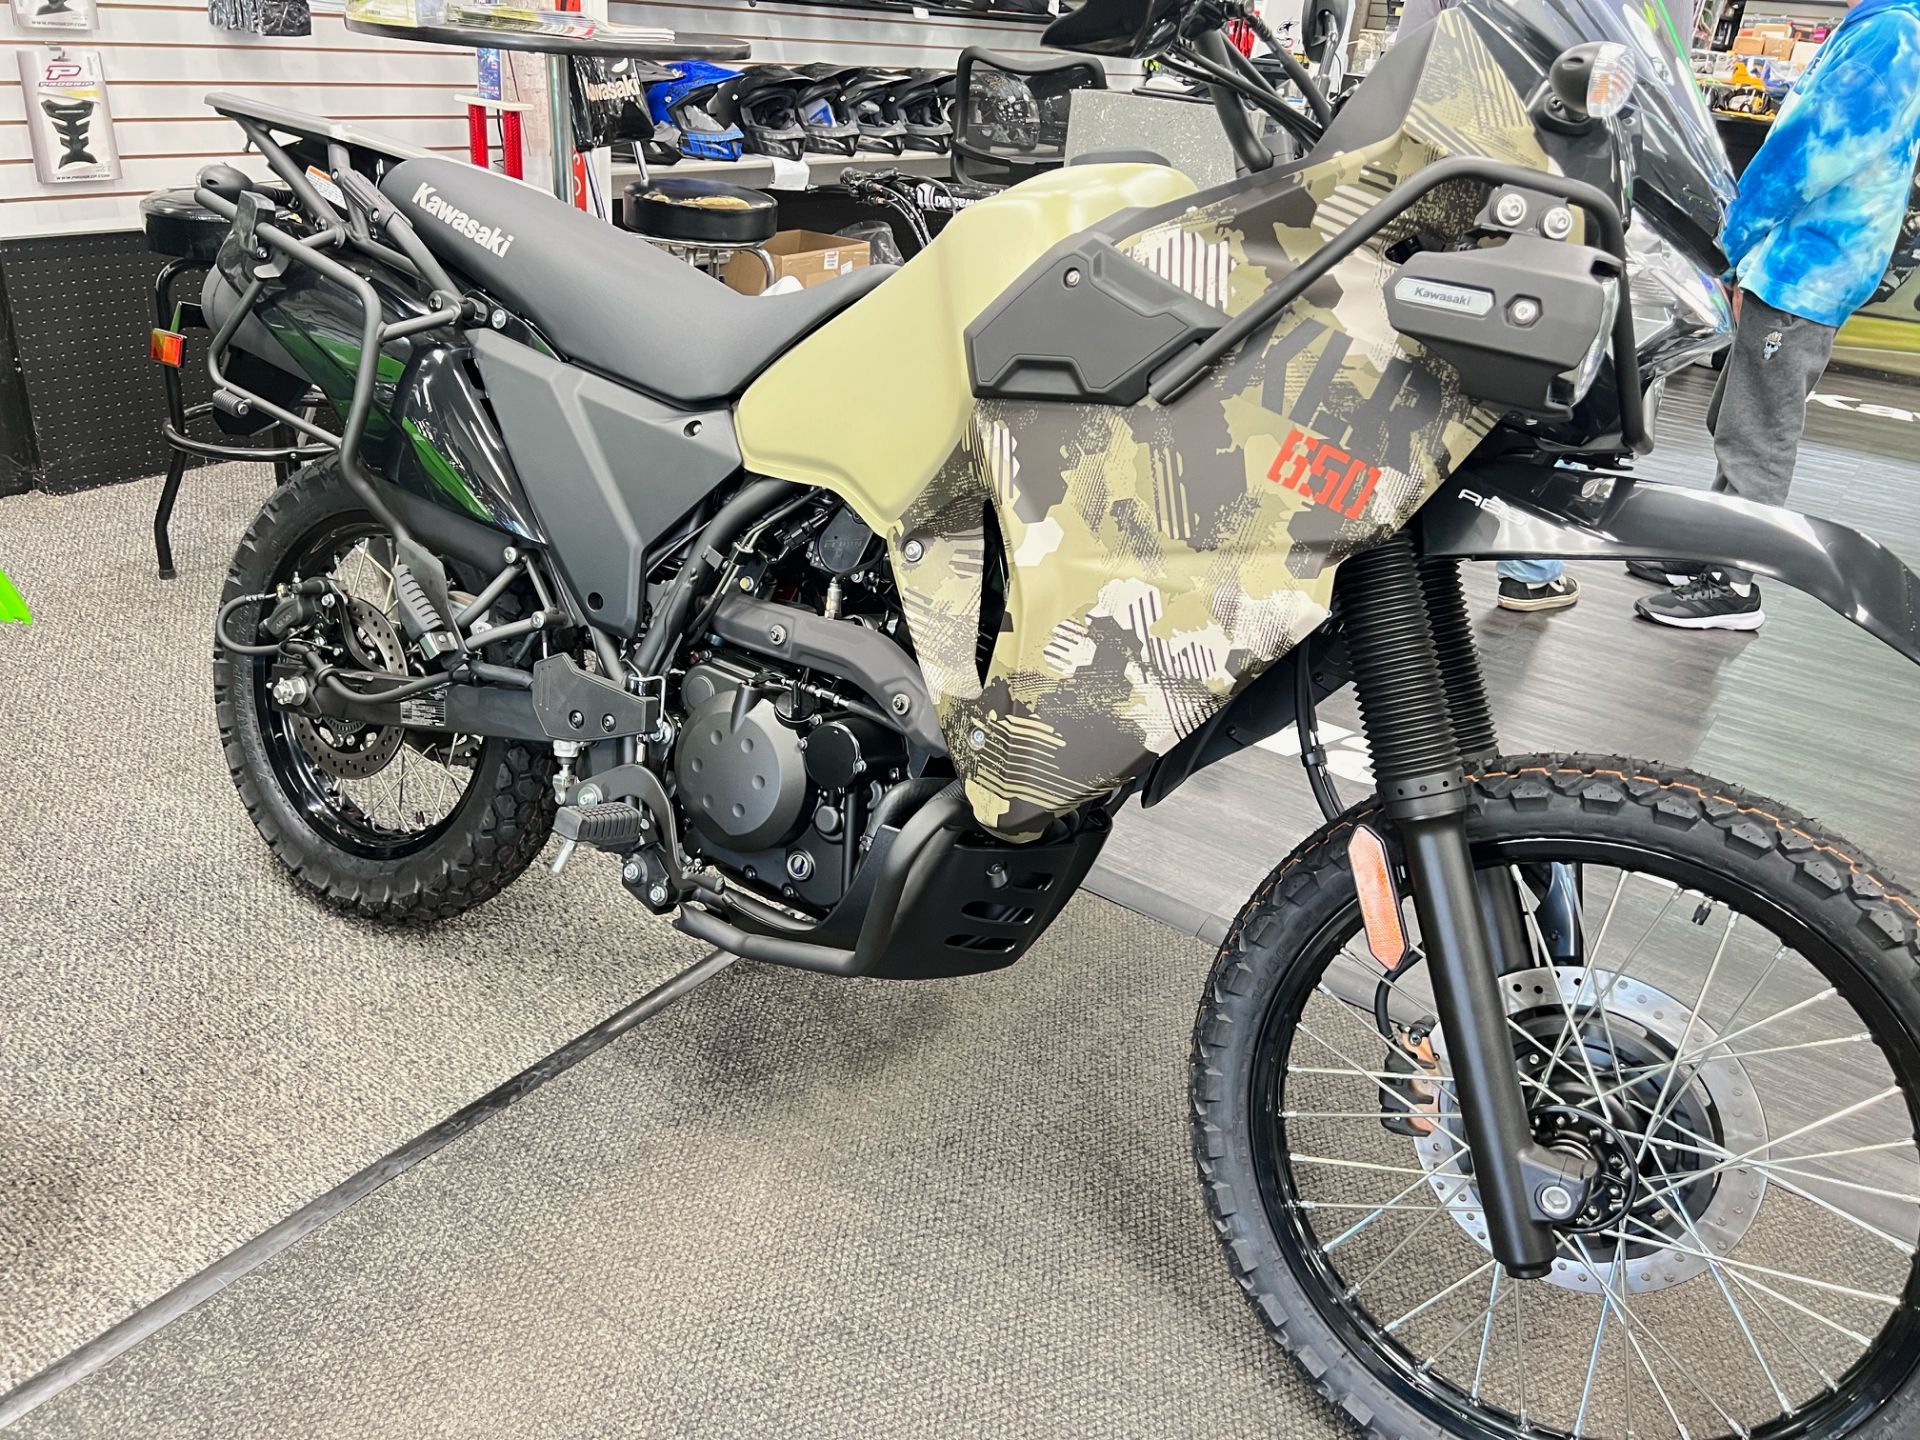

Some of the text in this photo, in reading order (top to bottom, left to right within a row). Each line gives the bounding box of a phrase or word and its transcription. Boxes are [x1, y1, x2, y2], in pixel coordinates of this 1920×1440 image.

[411, 182, 515, 258] Kawasaki
[1414, 286, 1472, 306] Kawasaki
[1267, 427, 1382, 520] 650
